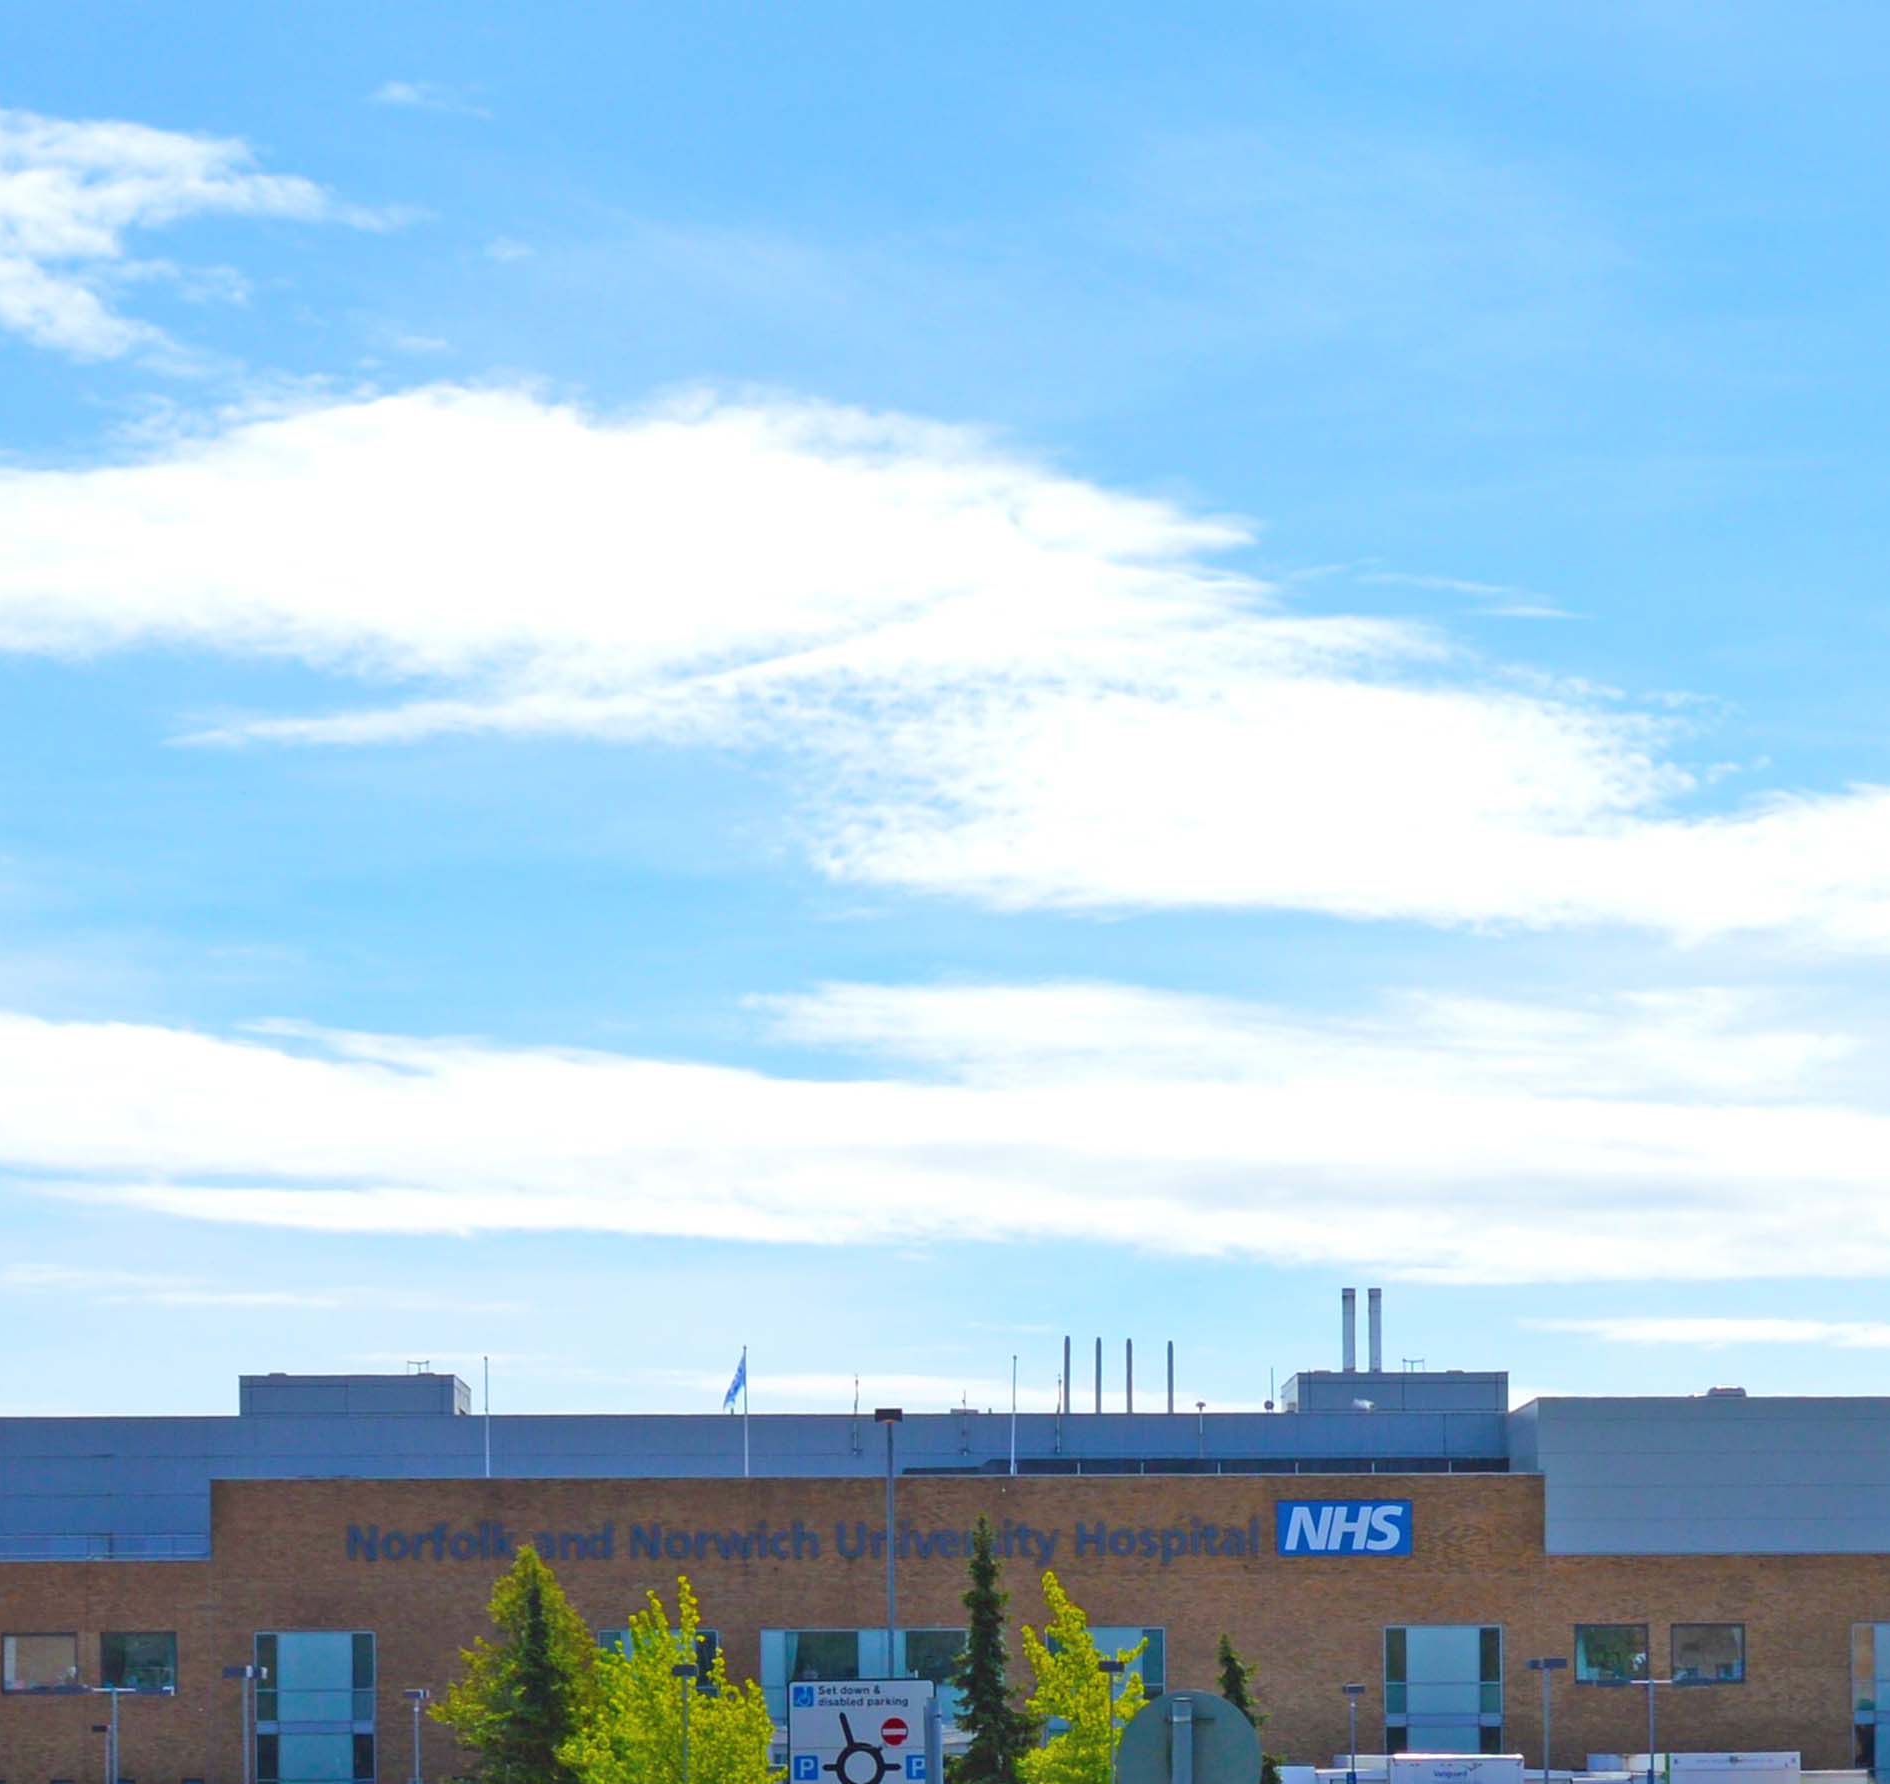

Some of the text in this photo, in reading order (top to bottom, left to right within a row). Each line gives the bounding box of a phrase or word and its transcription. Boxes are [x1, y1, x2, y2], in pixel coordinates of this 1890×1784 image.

[346, 1518, 515, 1561] Norfolk
[530, 1520, 616, 1560] and
[629, 1519, 822, 1560] Norwich
[1074, 1516, 1261, 1566] Hospital
[1284, 1505, 1404, 1551] NHS
[818, 1686, 881, 1695] Set down &
[818, 1697, 909, 1708] disabled parking
